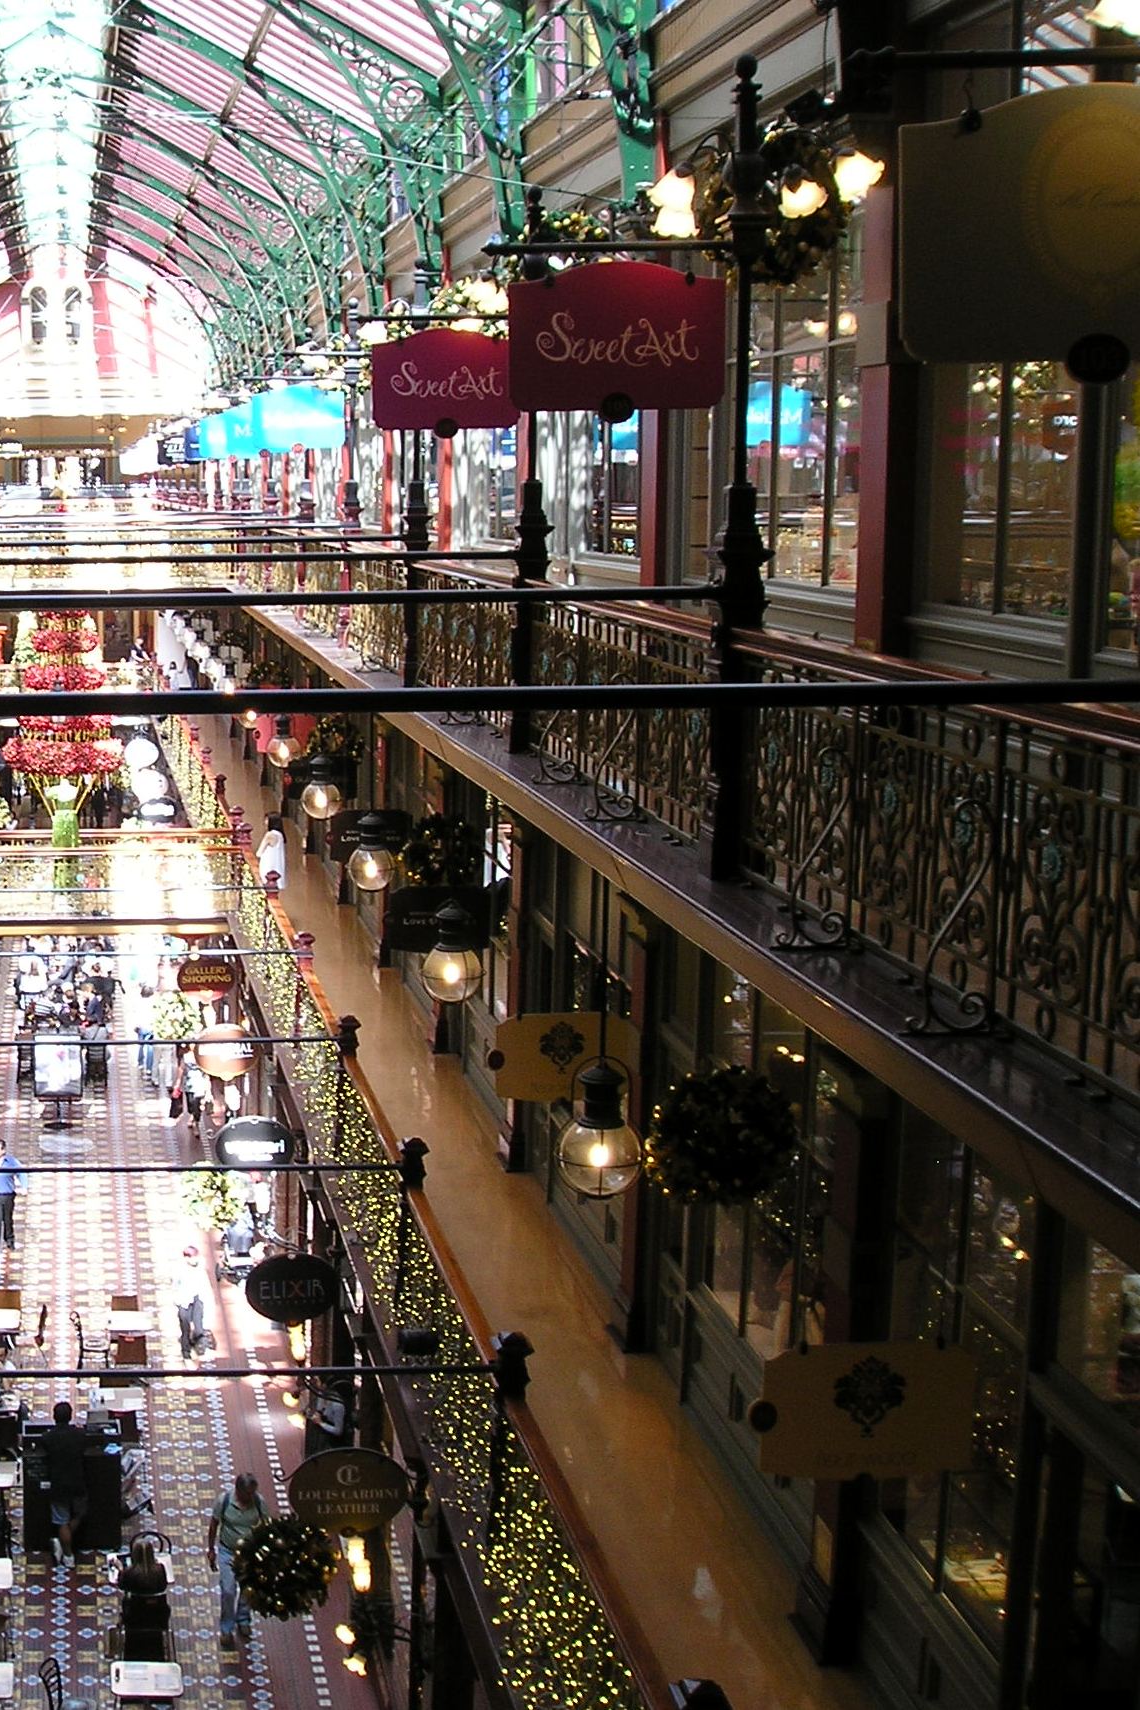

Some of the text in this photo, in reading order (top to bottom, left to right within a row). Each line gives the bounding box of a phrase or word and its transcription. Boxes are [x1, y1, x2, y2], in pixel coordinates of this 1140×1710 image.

[536, 310, 699, 367] Sweet Art
[390, 361, 503, 400] Sweet Art
[185, 966, 227, 975] GALLERY
[182, 974, 232, 984] SHOPPING
[260, 1279, 325, 1299] ELIXIR
[298, 1488, 399, 1502] LOUIS CARDINI
[317, 1503, 380, 1515] LEATHER
